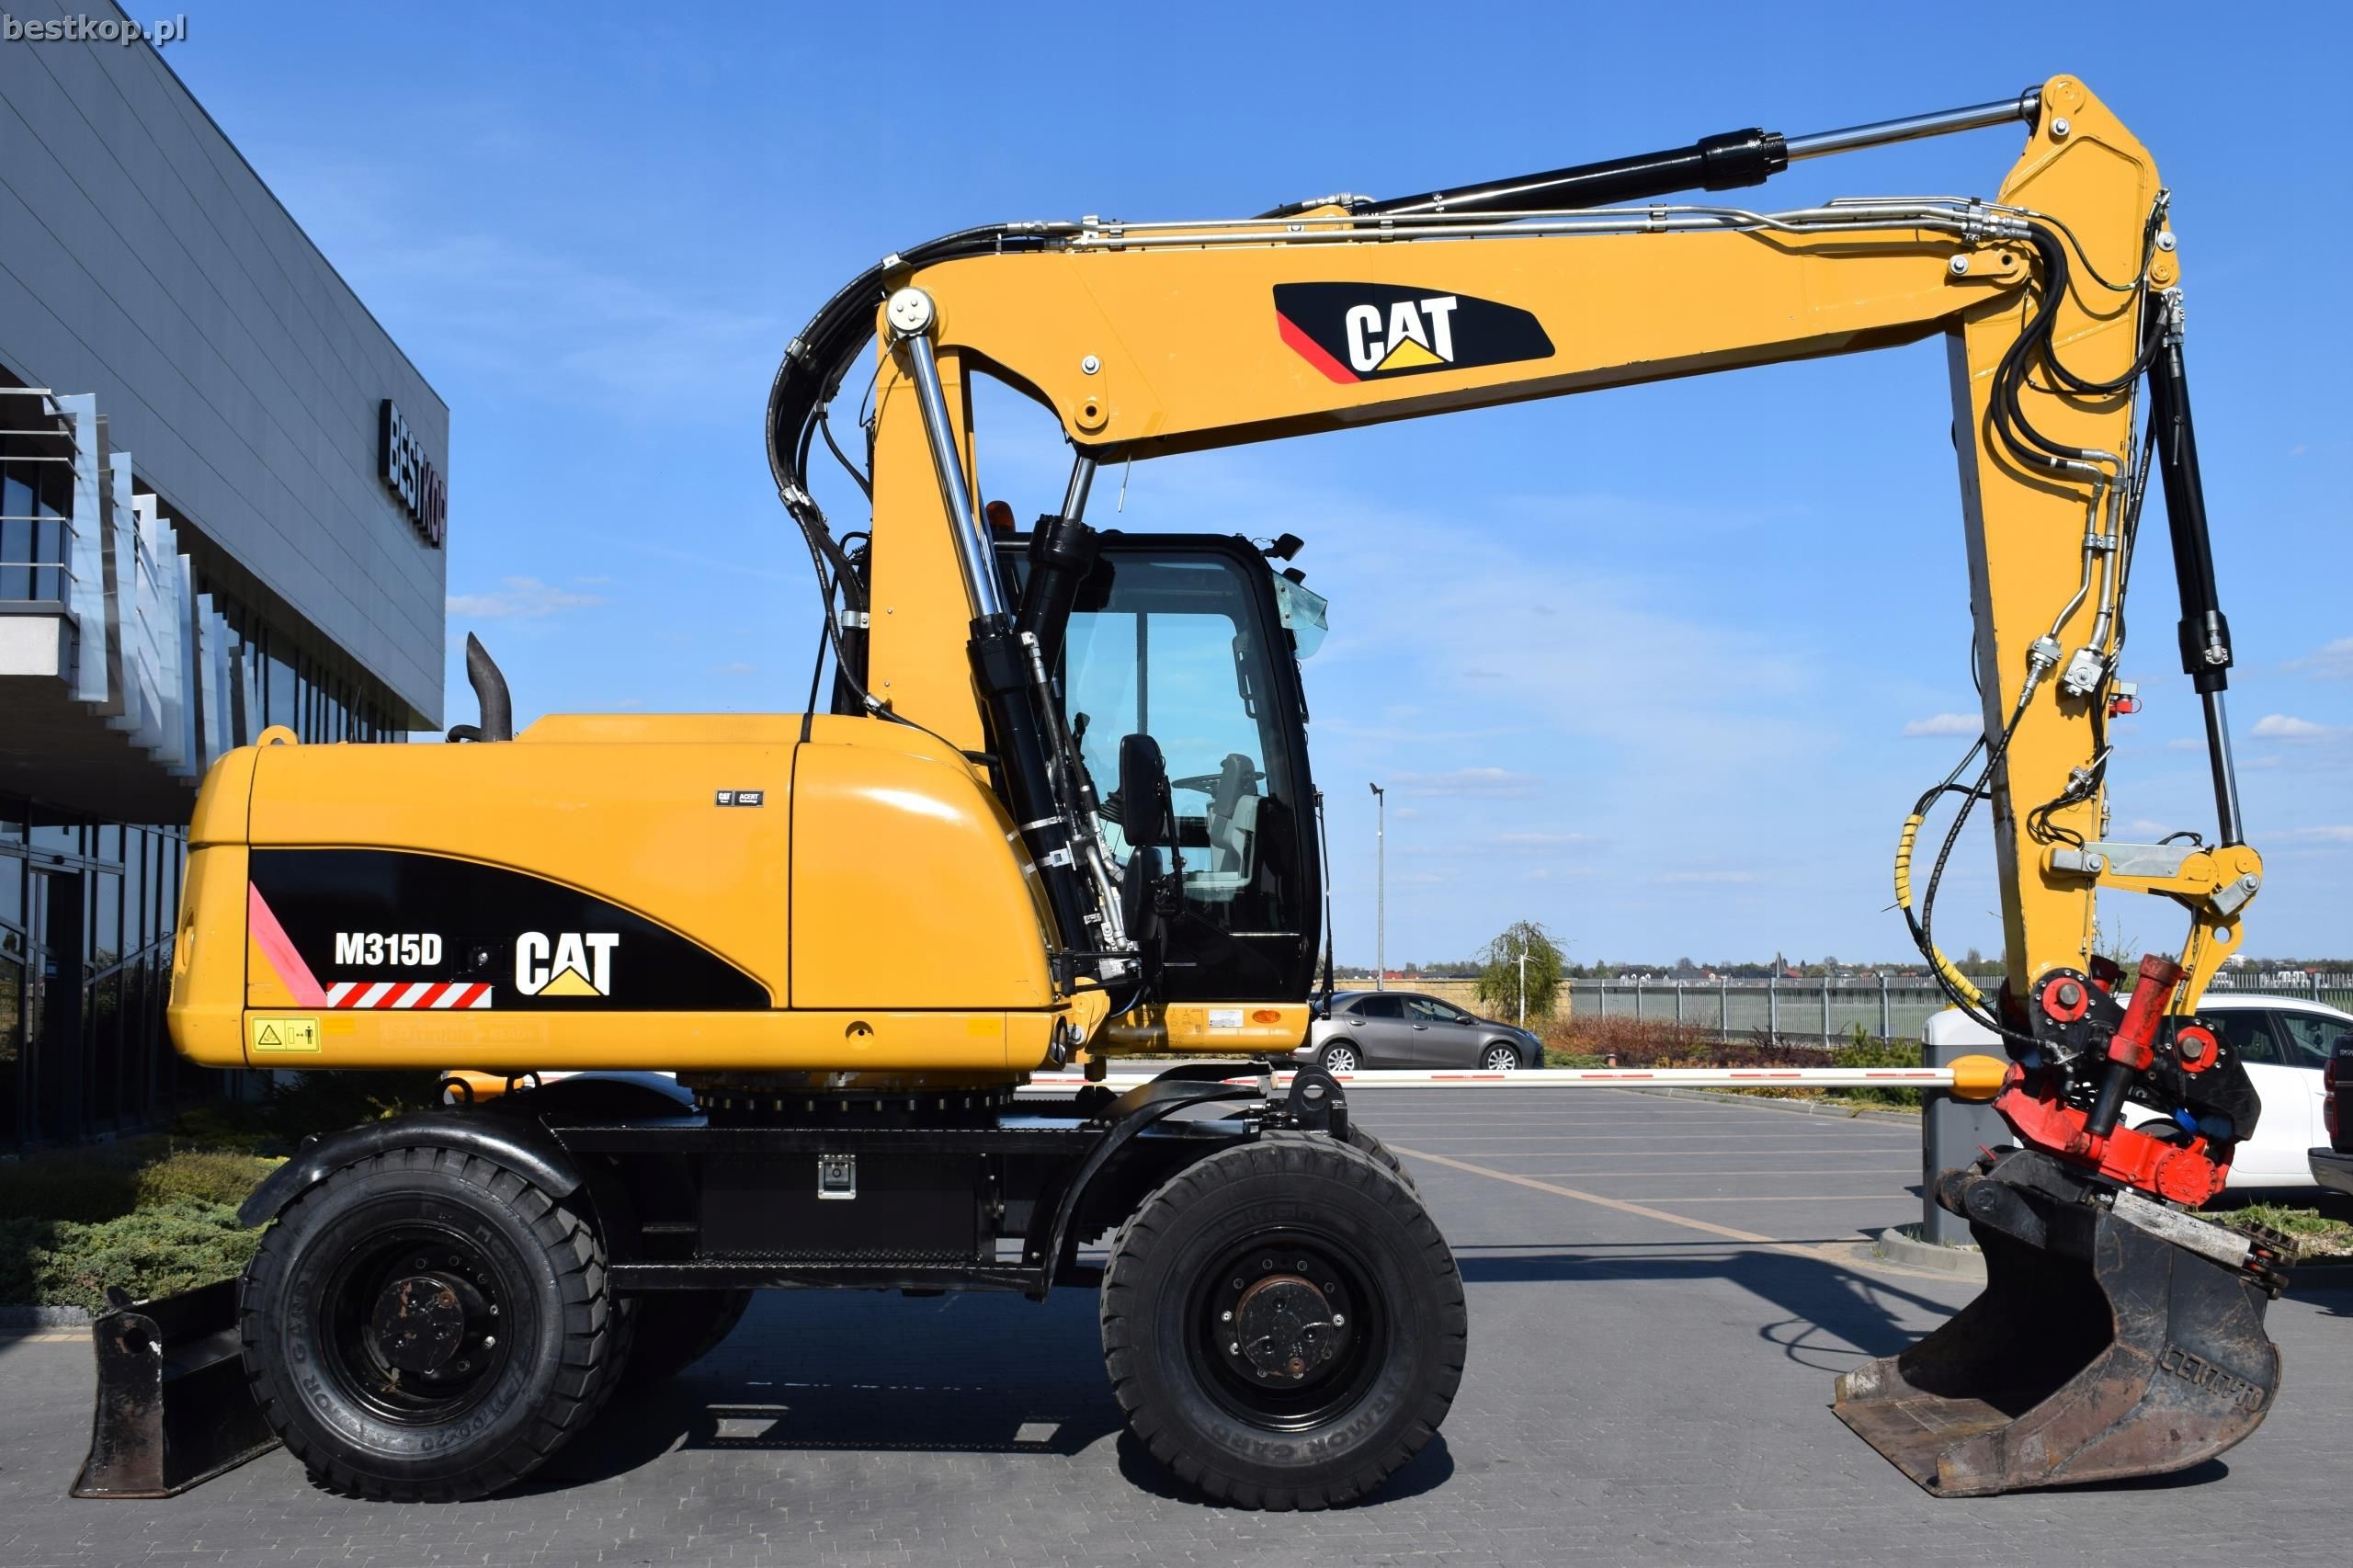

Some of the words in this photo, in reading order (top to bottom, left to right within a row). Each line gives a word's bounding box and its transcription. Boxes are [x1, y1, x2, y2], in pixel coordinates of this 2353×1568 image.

[1346, 296, 1457, 372] CAT
[387, 399, 447, 549] BESTKOP
[335, 932, 442, 966] M315D
[516, 931, 620, 995] CAT
